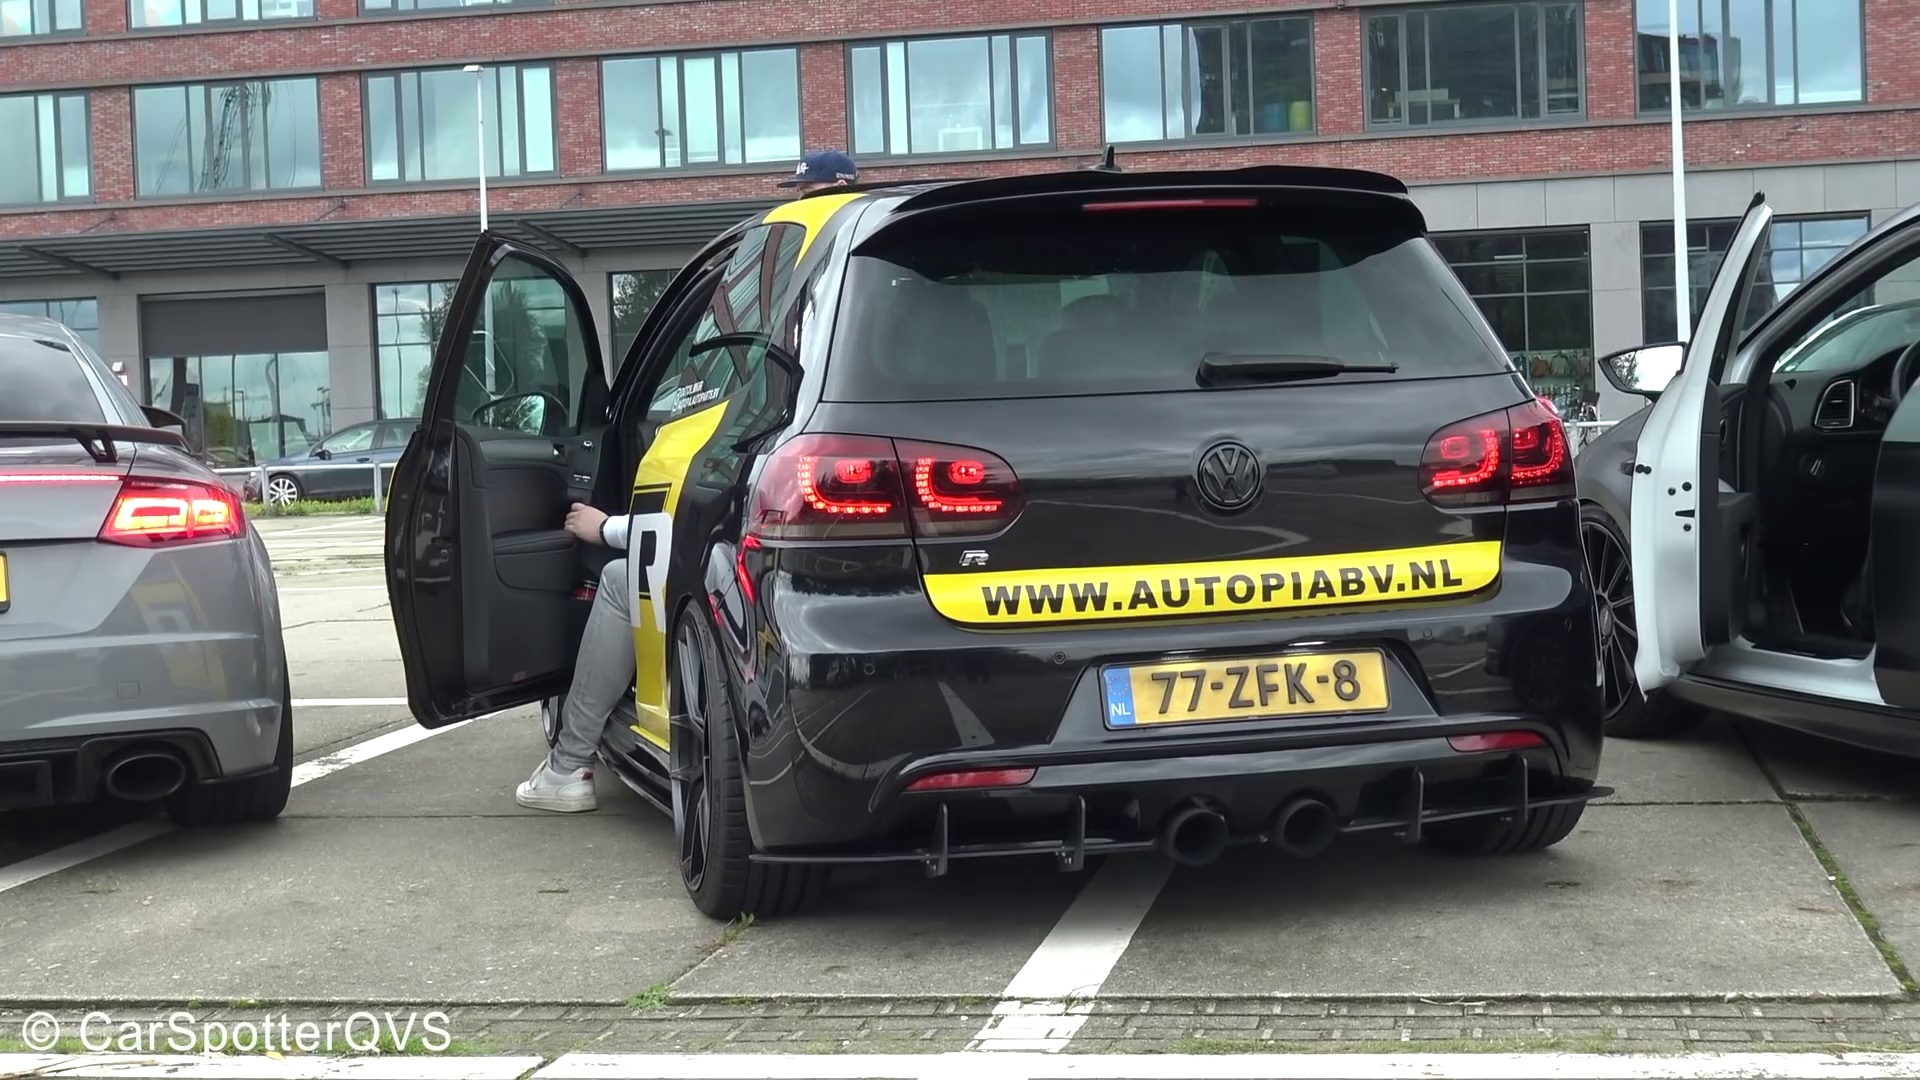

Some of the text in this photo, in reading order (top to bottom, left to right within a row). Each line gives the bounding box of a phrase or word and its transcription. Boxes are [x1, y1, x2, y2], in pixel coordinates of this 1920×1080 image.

[959, 550, 989, 567] R
[981, 558, 1463, 616] WWW.AUTOPIABV.NL
[1151, 659, 1361, 714] 77-ZFK-8
[1110, 702, 1132, 717] NL
